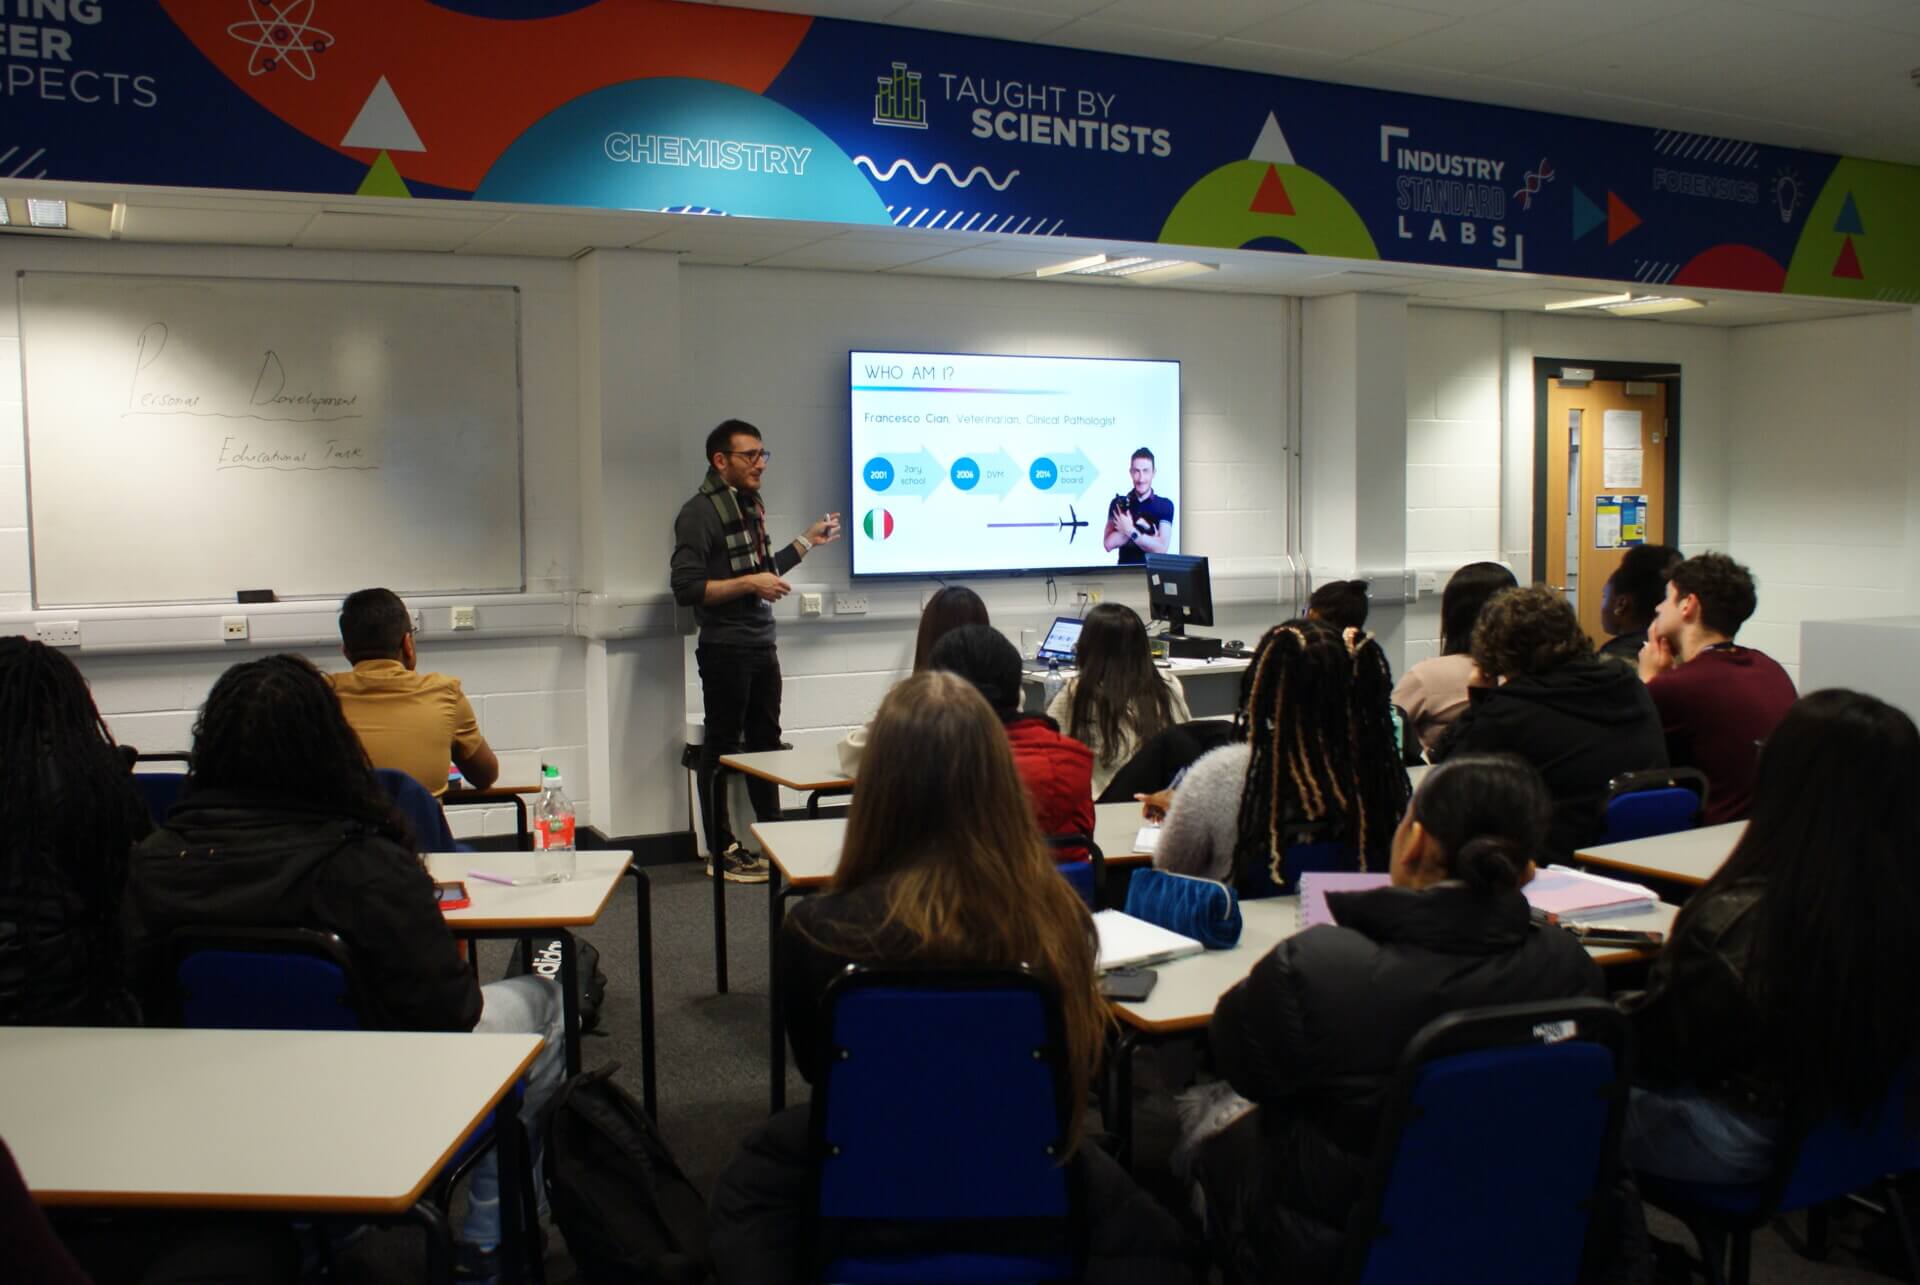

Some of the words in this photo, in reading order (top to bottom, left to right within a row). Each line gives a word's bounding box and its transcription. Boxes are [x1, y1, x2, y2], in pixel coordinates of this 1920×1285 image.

[0, 0, 103, 25] ING
[0, 64, 157, 108] PECTS
[939, 73, 1067, 113] TAUGHT
[1077, 89, 1117, 118] BY
[971, 108, 1172, 157] SCIENTISTS
[604, 131, 812, 176] CHEMISTRY
[1397, 148, 1505, 182] INDUSTRY
[1396, 175, 1505, 220] STANDARD
[1652, 168, 1760, 204] FORENSICS
[864, 365, 904, 380] WHO
[911, 366, 936, 380] AM
[942, 366, 955, 381] I?
[864, 412, 921, 424] Francesco
[1026, 414, 1061, 425] Clinical
[1063, 415, 1117, 428] Pathologist
[900, 476, 926, 486] school
[986, 470, 1005, 479] DVM
[1060, 476, 1084, 485] board
